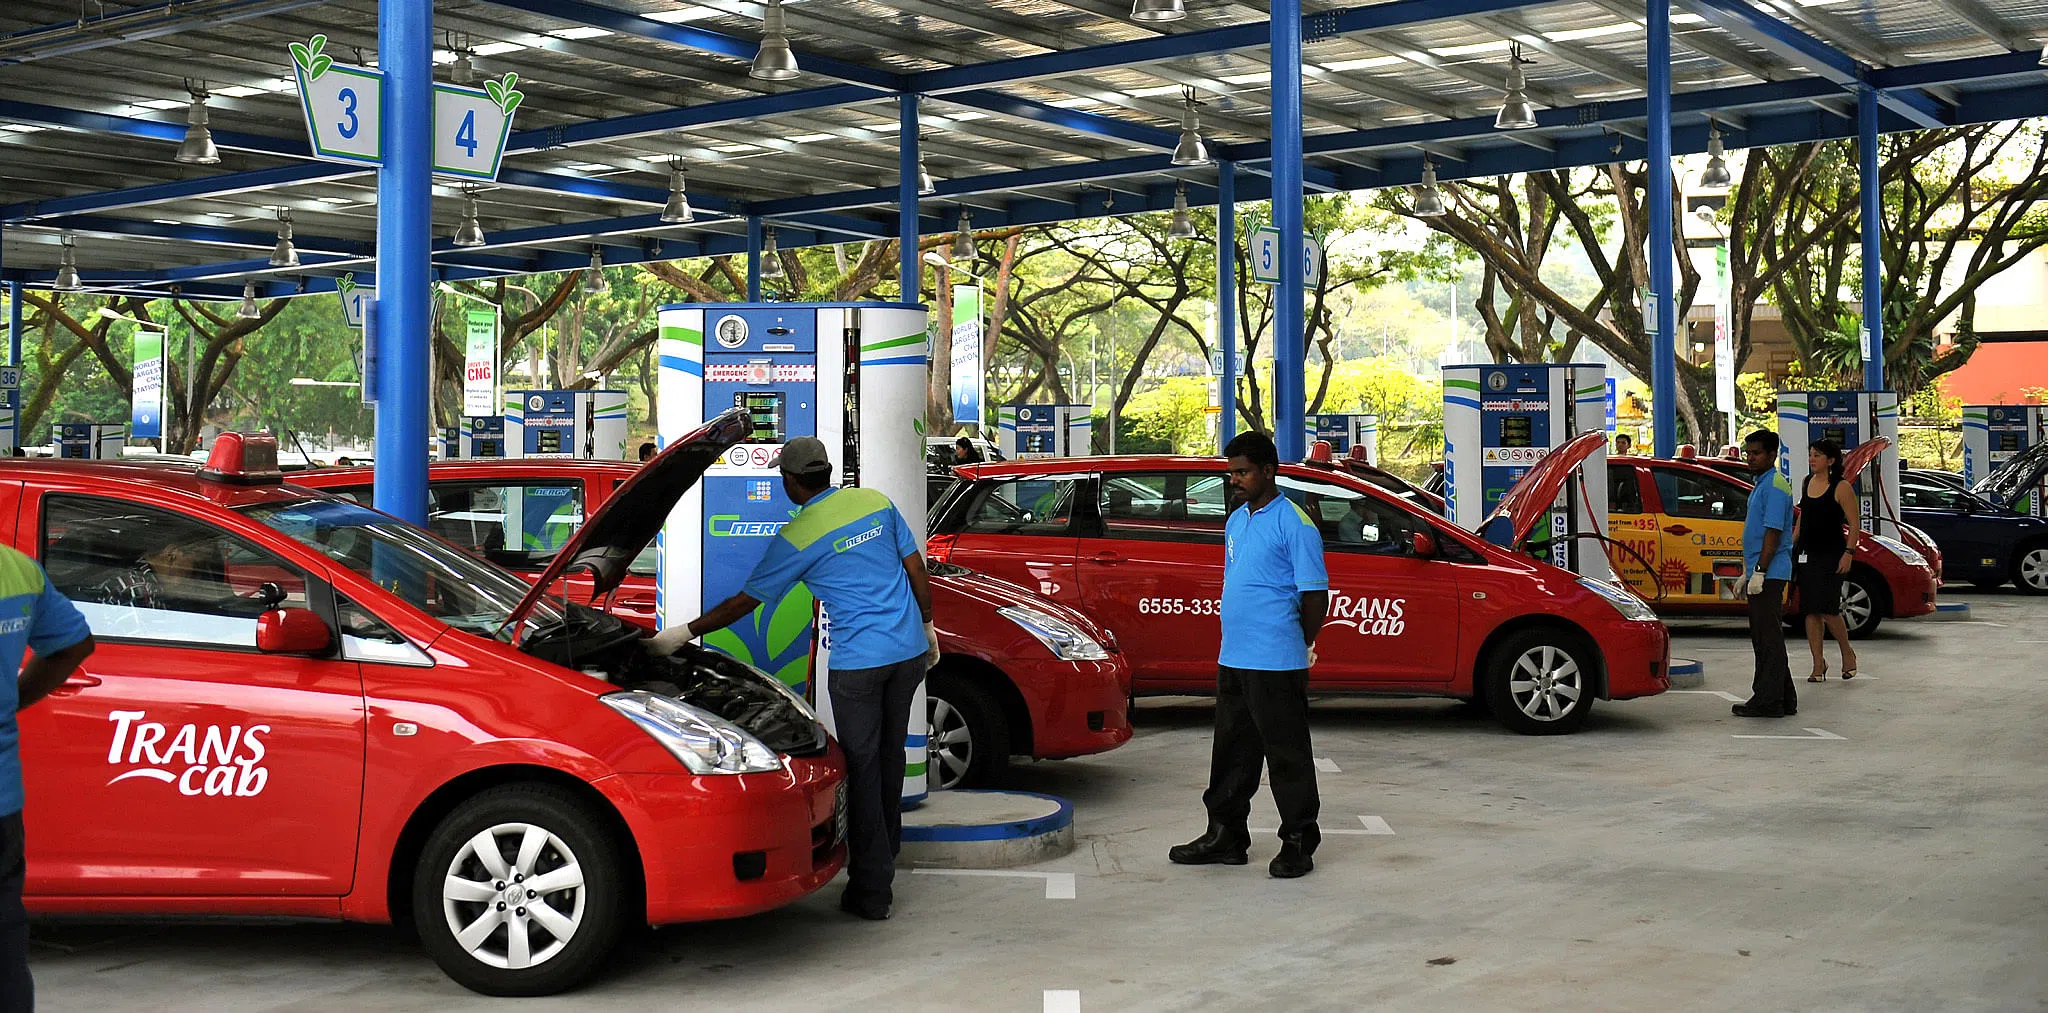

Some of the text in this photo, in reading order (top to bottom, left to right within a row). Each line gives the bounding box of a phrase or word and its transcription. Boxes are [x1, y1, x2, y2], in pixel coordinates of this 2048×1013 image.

[337, 87, 359, 139] 3
[455, 109, 478, 158] 4
[1262, 240, 1272, 270] 5
[1304, 247, 1312, 276] 6
[1648, 303, 1654, 324] 7
[467, 366, 492, 381] CNG
[1214, 356, 1223, 370] 19
[1234, 357, 1243, 372] 20
[2, 371, 17, 385] 36
[1554, 515, 1566, 569] GALEO
[1709, 536, 1724, 546] 3A
[1138, 597, 1222, 616] 6555-333
[1326, 589, 1406, 619] TRANS
[1358, 615, 1406, 636] cab
[108, 710, 271, 766] TRANS
[178, 760, 269, 797] cab
